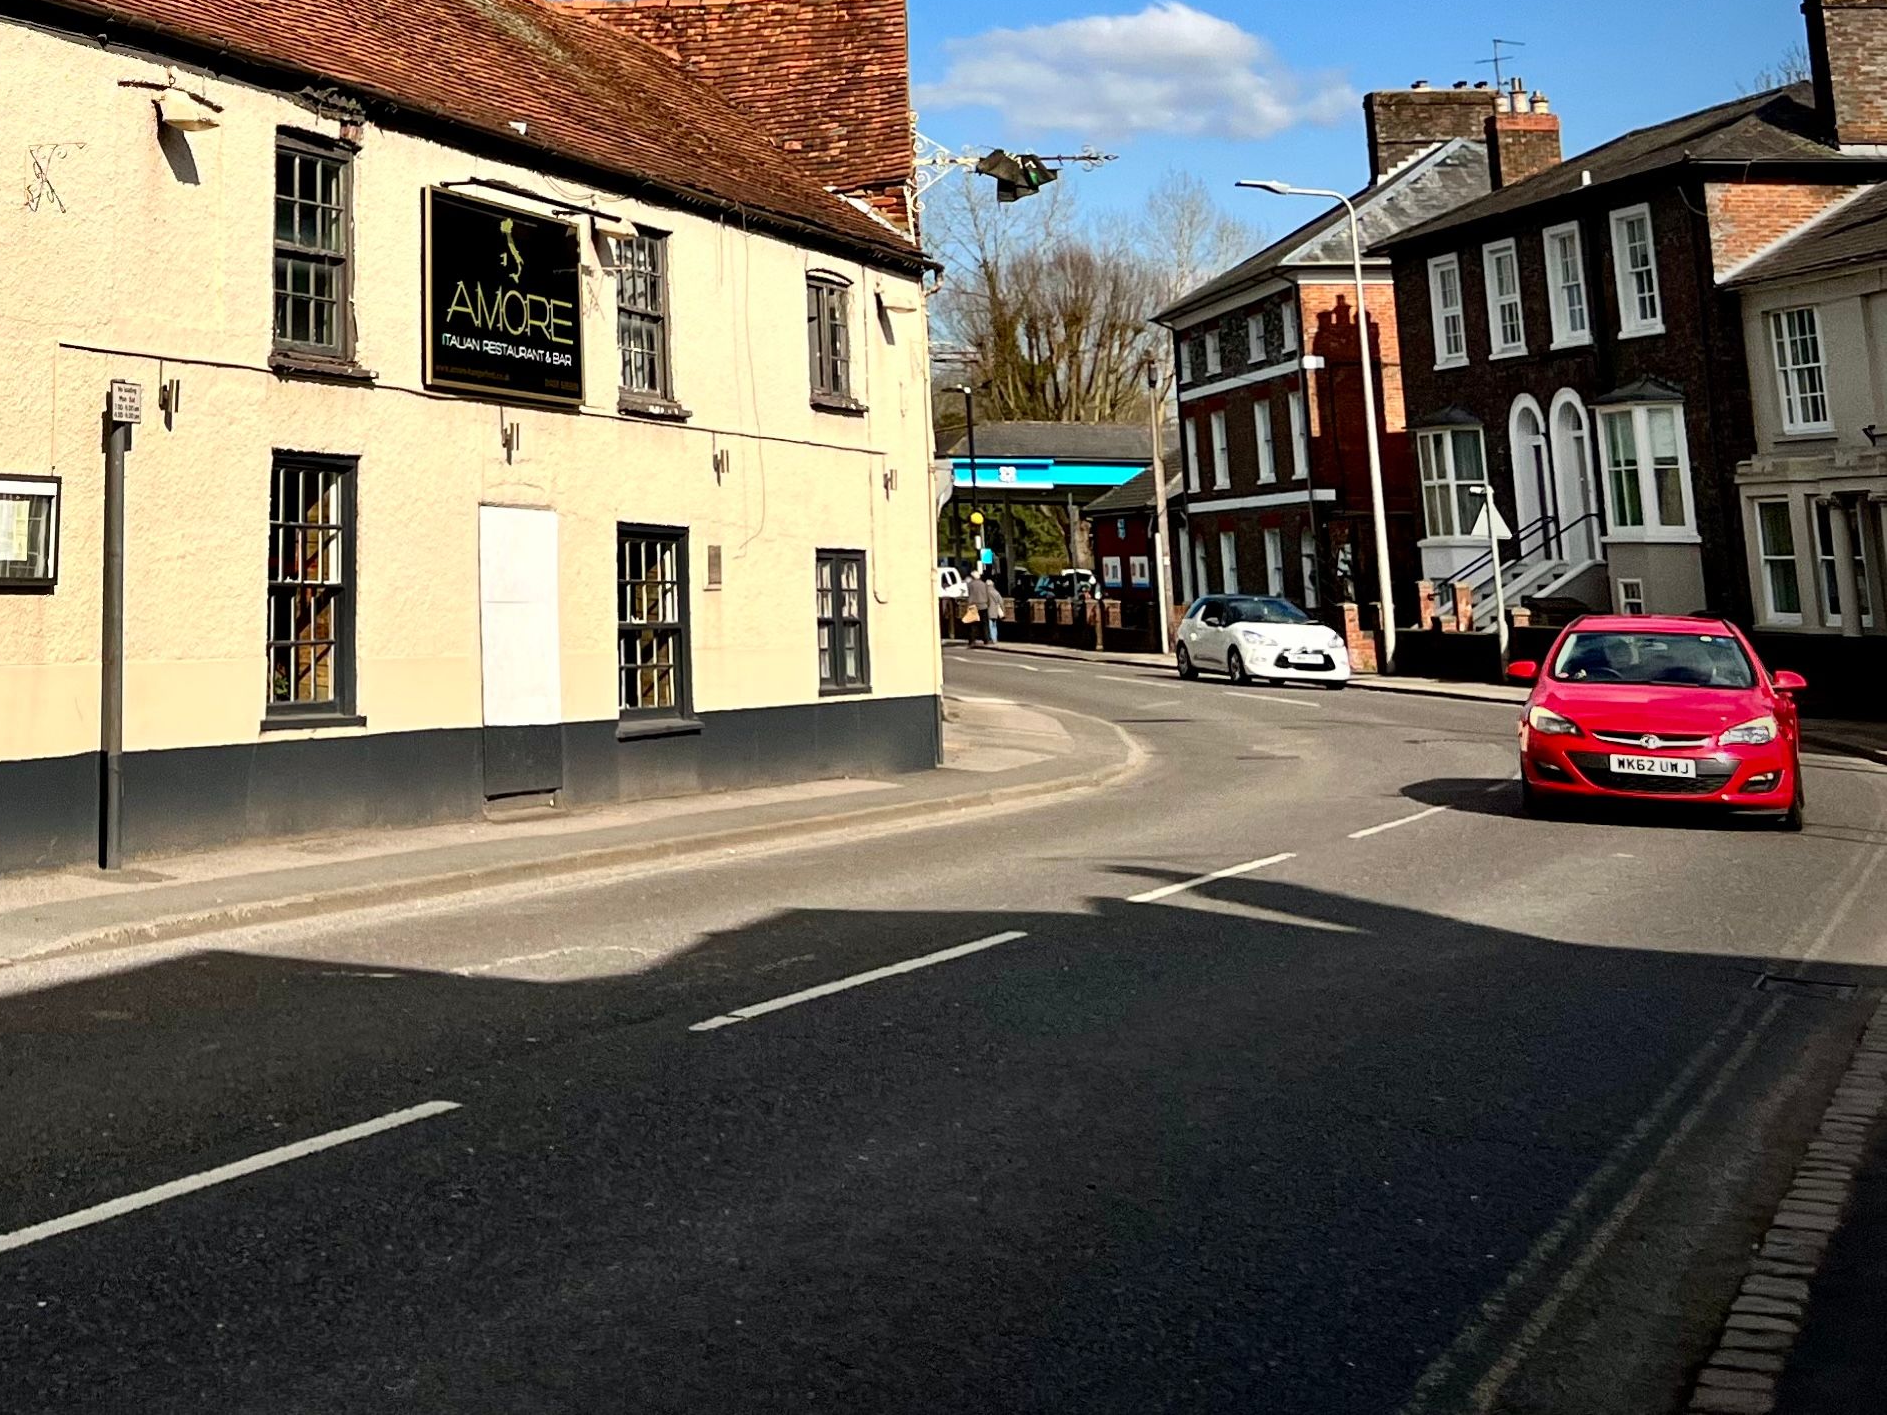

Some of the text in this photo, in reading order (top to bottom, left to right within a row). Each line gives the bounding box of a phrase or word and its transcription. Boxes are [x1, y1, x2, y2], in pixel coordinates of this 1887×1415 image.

[446, 280, 573, 345] AMORE
[442, 333, 572, 367] ITALIAN RESTAURANT & BAR
[1617, 757, 1689, 774] WK62 UWJ
